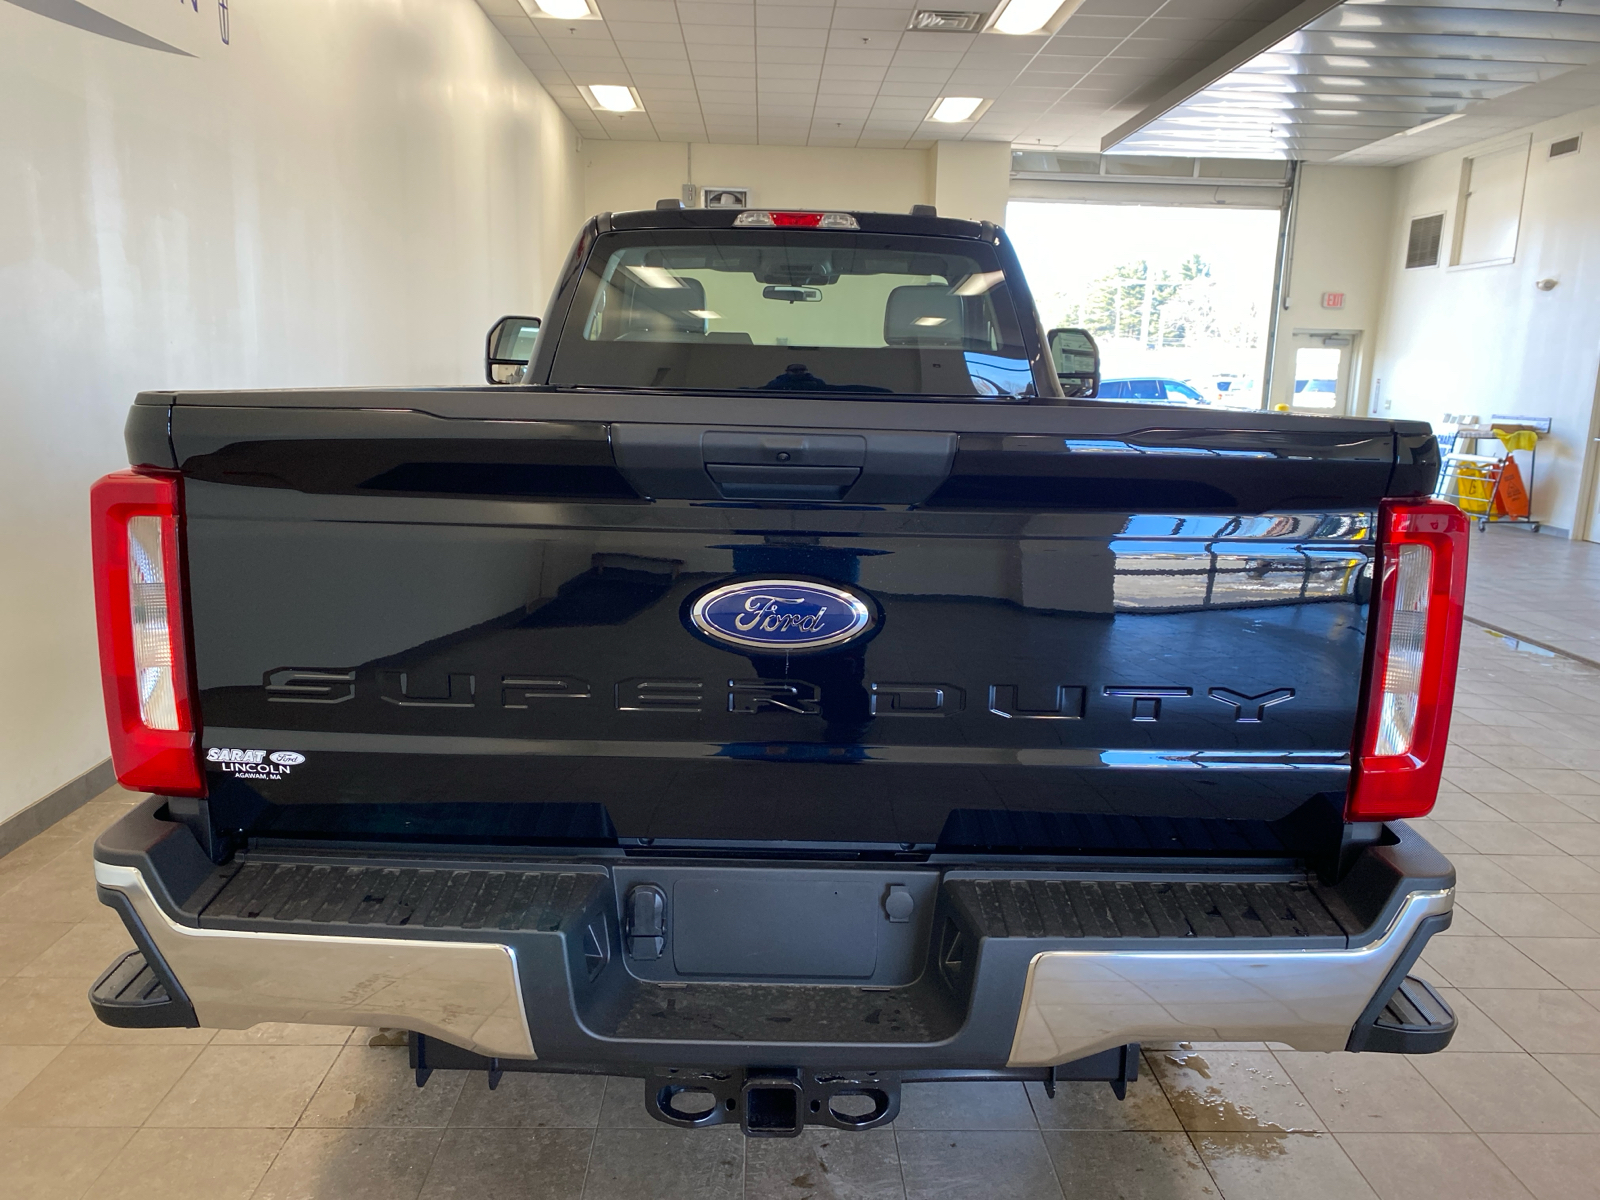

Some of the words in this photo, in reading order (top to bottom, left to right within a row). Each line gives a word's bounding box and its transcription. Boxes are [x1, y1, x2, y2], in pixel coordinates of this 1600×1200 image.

[1326, 293, 1344, 307] EXIT
[734, 595, 828, 632] Ford
[263, 666, 822, 715] SUPER
[868, 682, 1296, 723] DUTY
[207, 748, 266, 763] SARAT
[221, 763, 291, 774] LINCOLN
[235, 772, 269, 780] AGAWAM,
